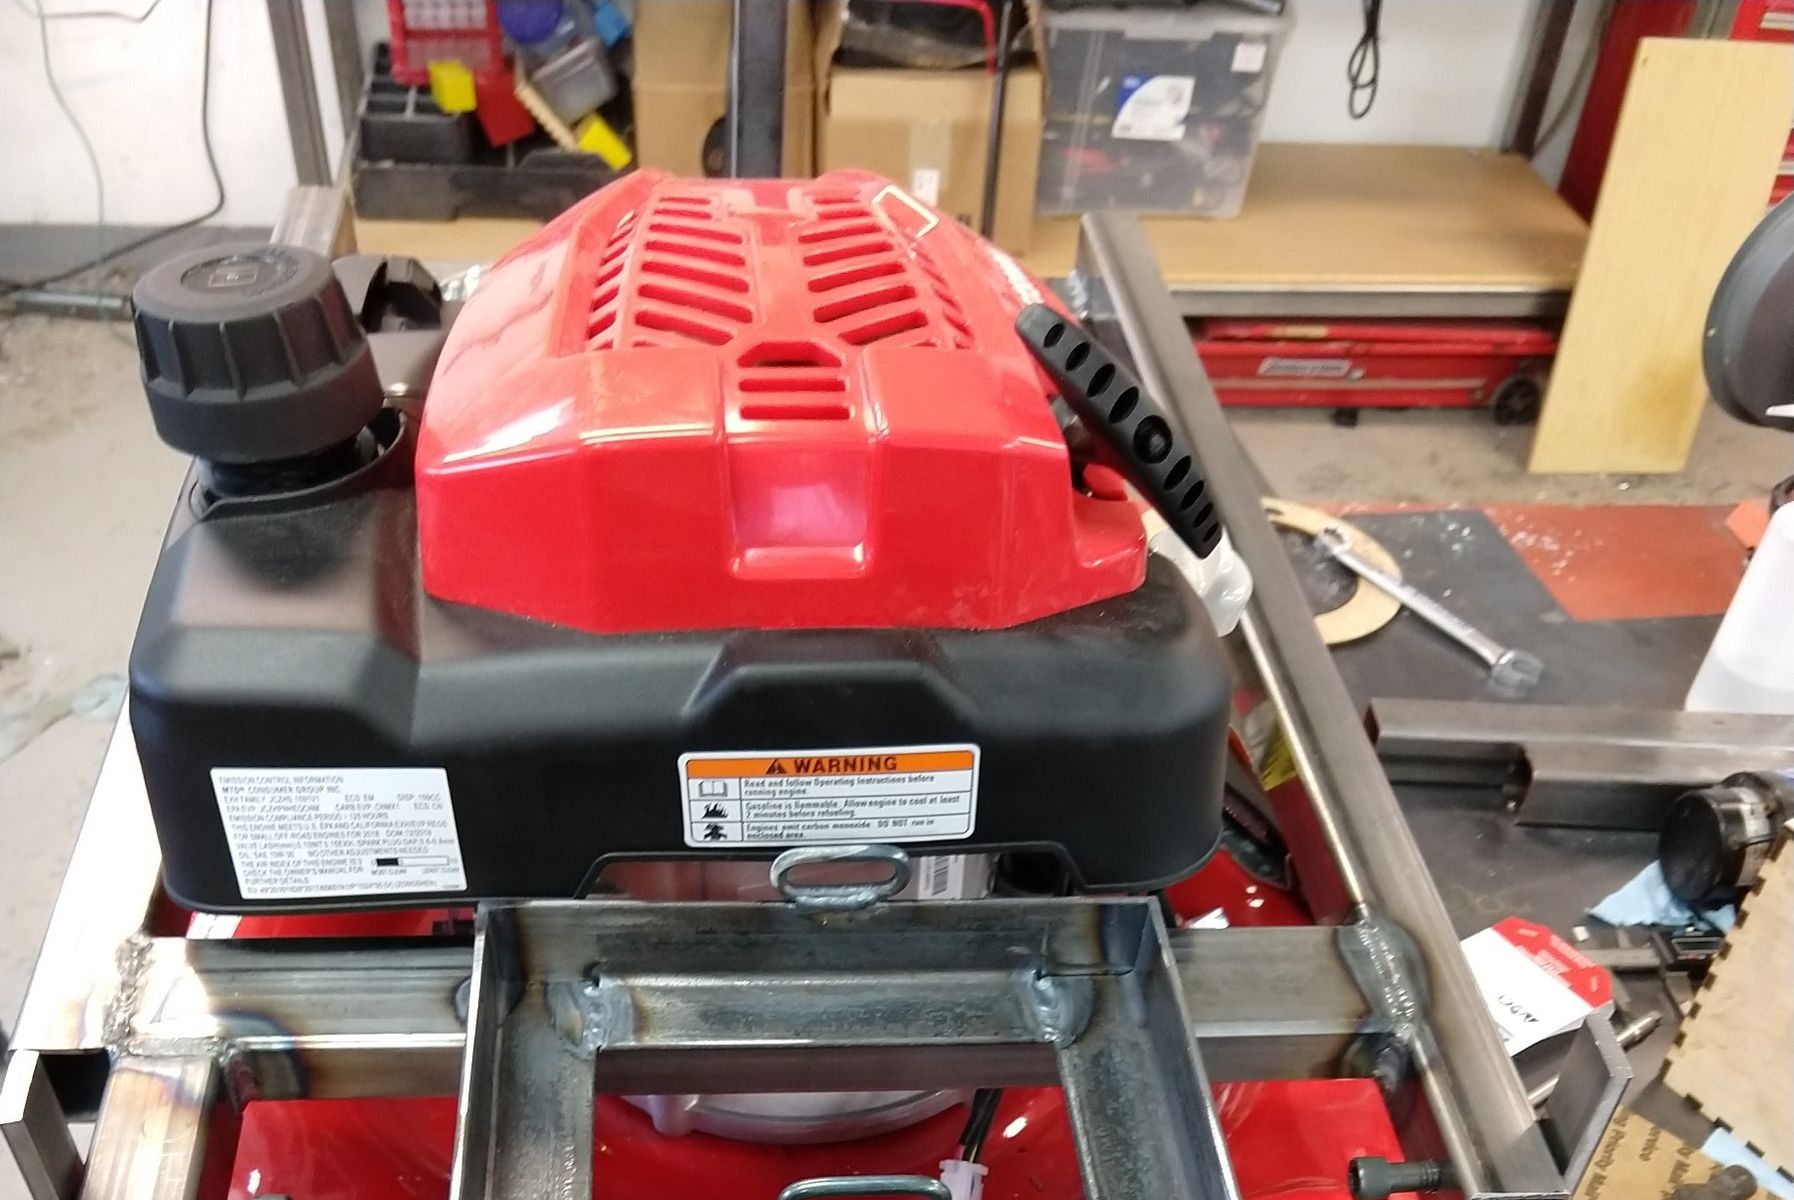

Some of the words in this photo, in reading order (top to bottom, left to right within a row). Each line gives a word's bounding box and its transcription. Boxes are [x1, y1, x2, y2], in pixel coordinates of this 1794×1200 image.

[794, 756, 897, 774] WARNING
[768, 779, 783, 787] and
[786, 778, 812, 786] follow
[908, 774, 935, 783] before
[295, 785, 324, 793] GROUP
[744, 789, 776, 797] running
[746, 802, 782, 810] Gasoline
[844, 799, 867, 807] Allow
[869, 799, 897, 808] engine
[909, 797, 927, 805] cool
[929, 796, 938, 804] at
[940, 795, 960, 803] least
[277, 822, 302, 830] MEETS
[747, 823, 778, 832] Engines
[801, 822, 829, 830] carbon
[892, 819, 908, 827] NOT
[1594, 1128, 1625, 1171] Priority
